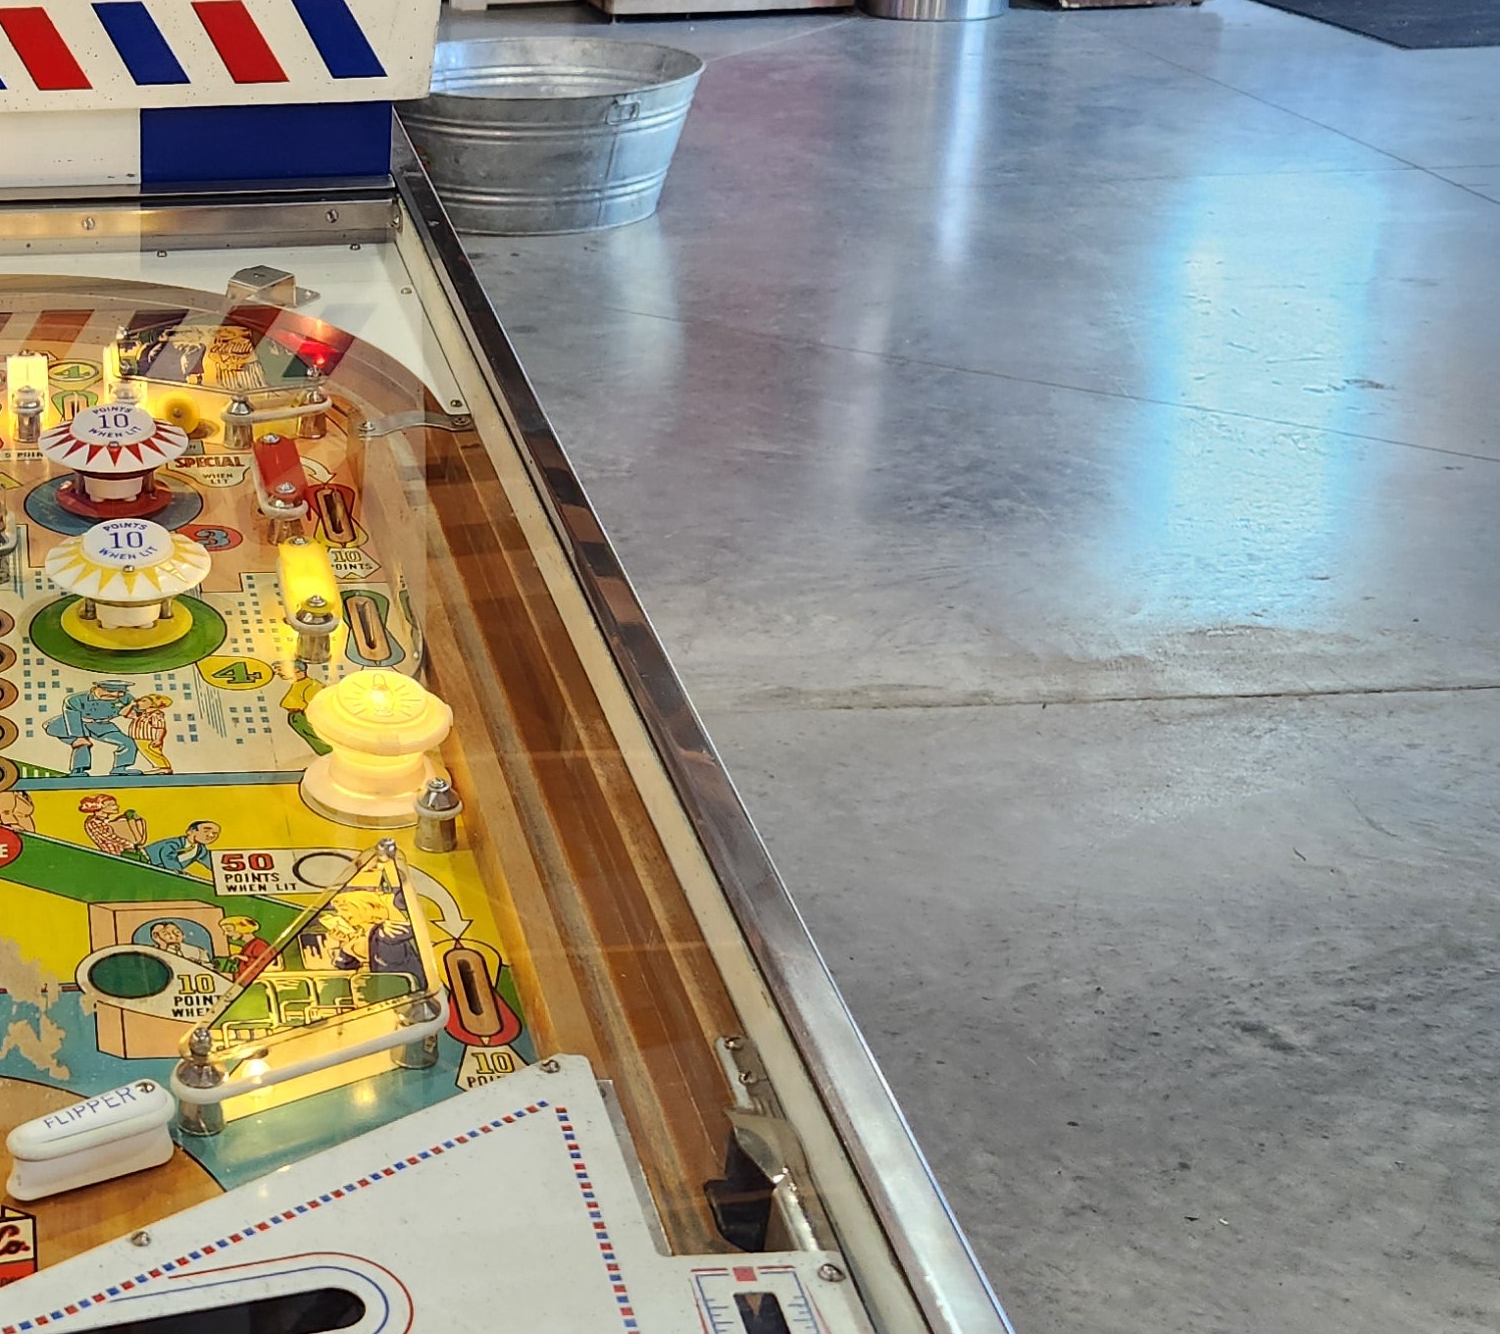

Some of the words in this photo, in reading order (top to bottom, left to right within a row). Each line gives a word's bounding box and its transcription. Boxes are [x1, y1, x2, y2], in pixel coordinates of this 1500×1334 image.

[92, 404, 133, 415] POINTS
[99, 413, 130, 429] 10
[88, 428, 123, 439] WHEN
[174, 456, 245, 468] SPECIAL
[102, 521, 148, 533] POINTS
[108, 530, 145, 550] 10
[98, 547, 139, 560] WHEN
[332, 550, 363, 563] 10
[211, 661, 264, 685] 4
[220, 853, 275, 871] 50
[223, 871, 281, 883] POINTS
[226, 883, 270, 893] WHEN
[276, 882, 298, 892] LIT
[177, 974, 216, 994] 10
[475, 1053, 514, 1075] 10
[42, 1085, 139, 1130] FLIPPER
